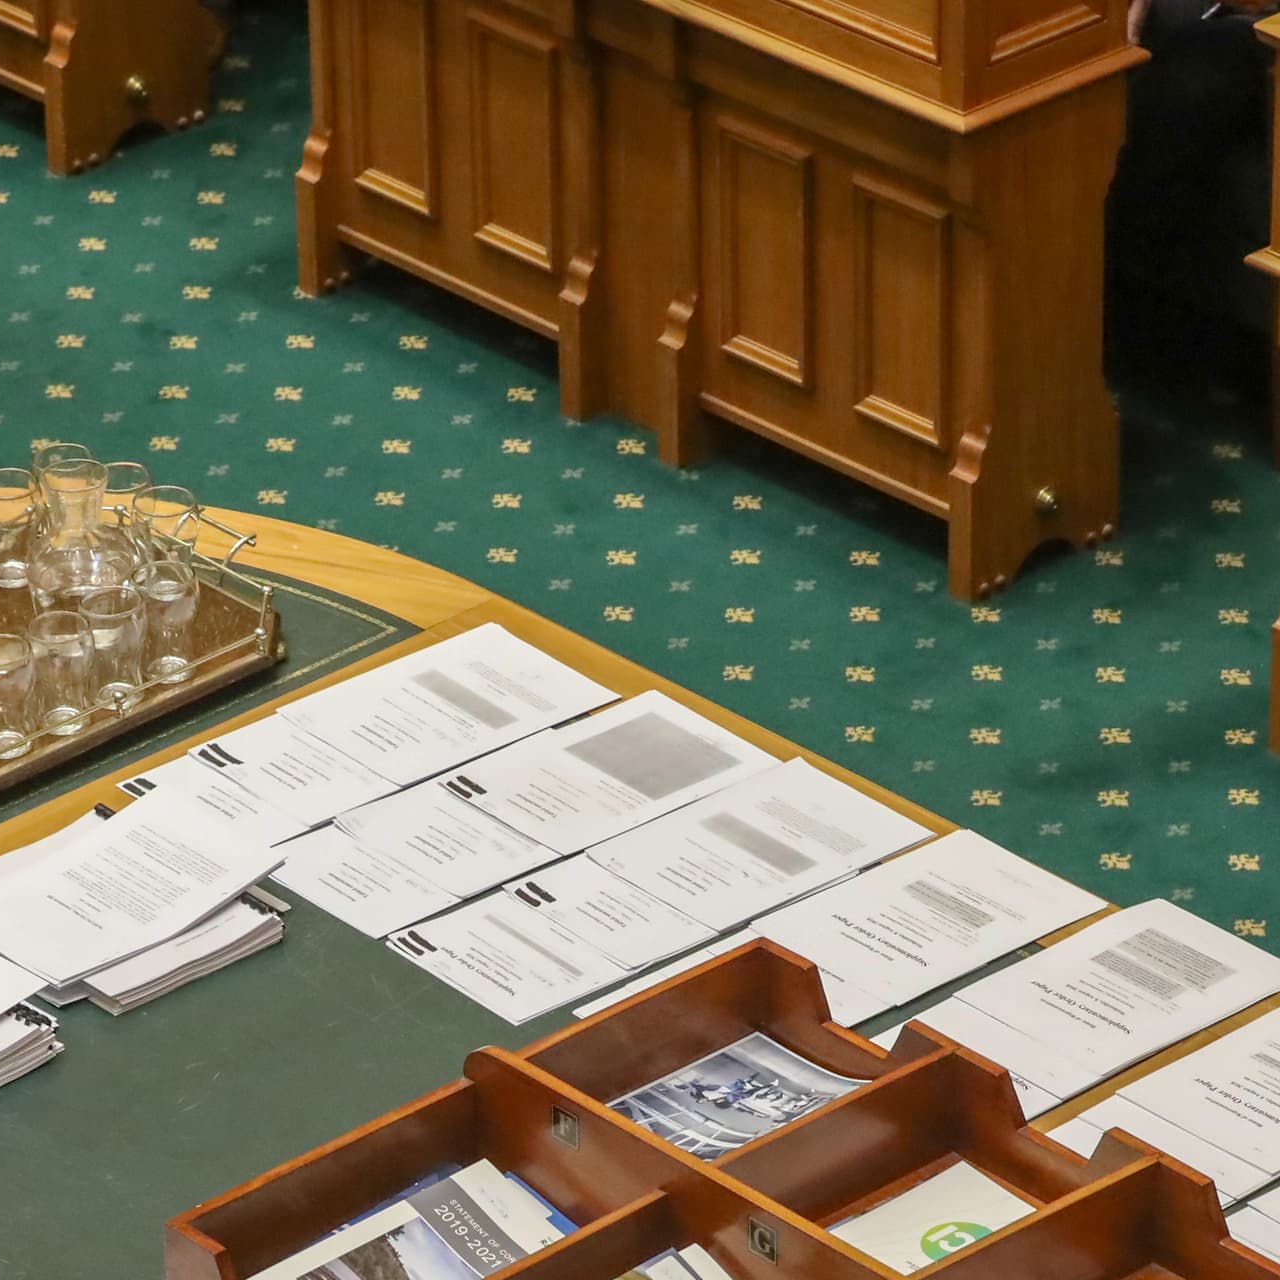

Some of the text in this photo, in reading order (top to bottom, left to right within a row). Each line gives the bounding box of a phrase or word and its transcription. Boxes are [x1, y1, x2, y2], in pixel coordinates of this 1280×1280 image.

[831, 914, 928, 967] Supplementary Order Paper
[1030, 980, 1133, 1035] Supplementary Order Paper
[1194, 1077, 1219, 1092] Paper
[1219, 1090, 1243, 1104] Order
[559, 1112, 570, 1137] F
[434, 1204, 503, 1269] 2019-2021
[449, 1199, 489, 1238] STATEMENT
[487, 1239, 500, 1249] OF
[753, 1227, 771, 1253] G
